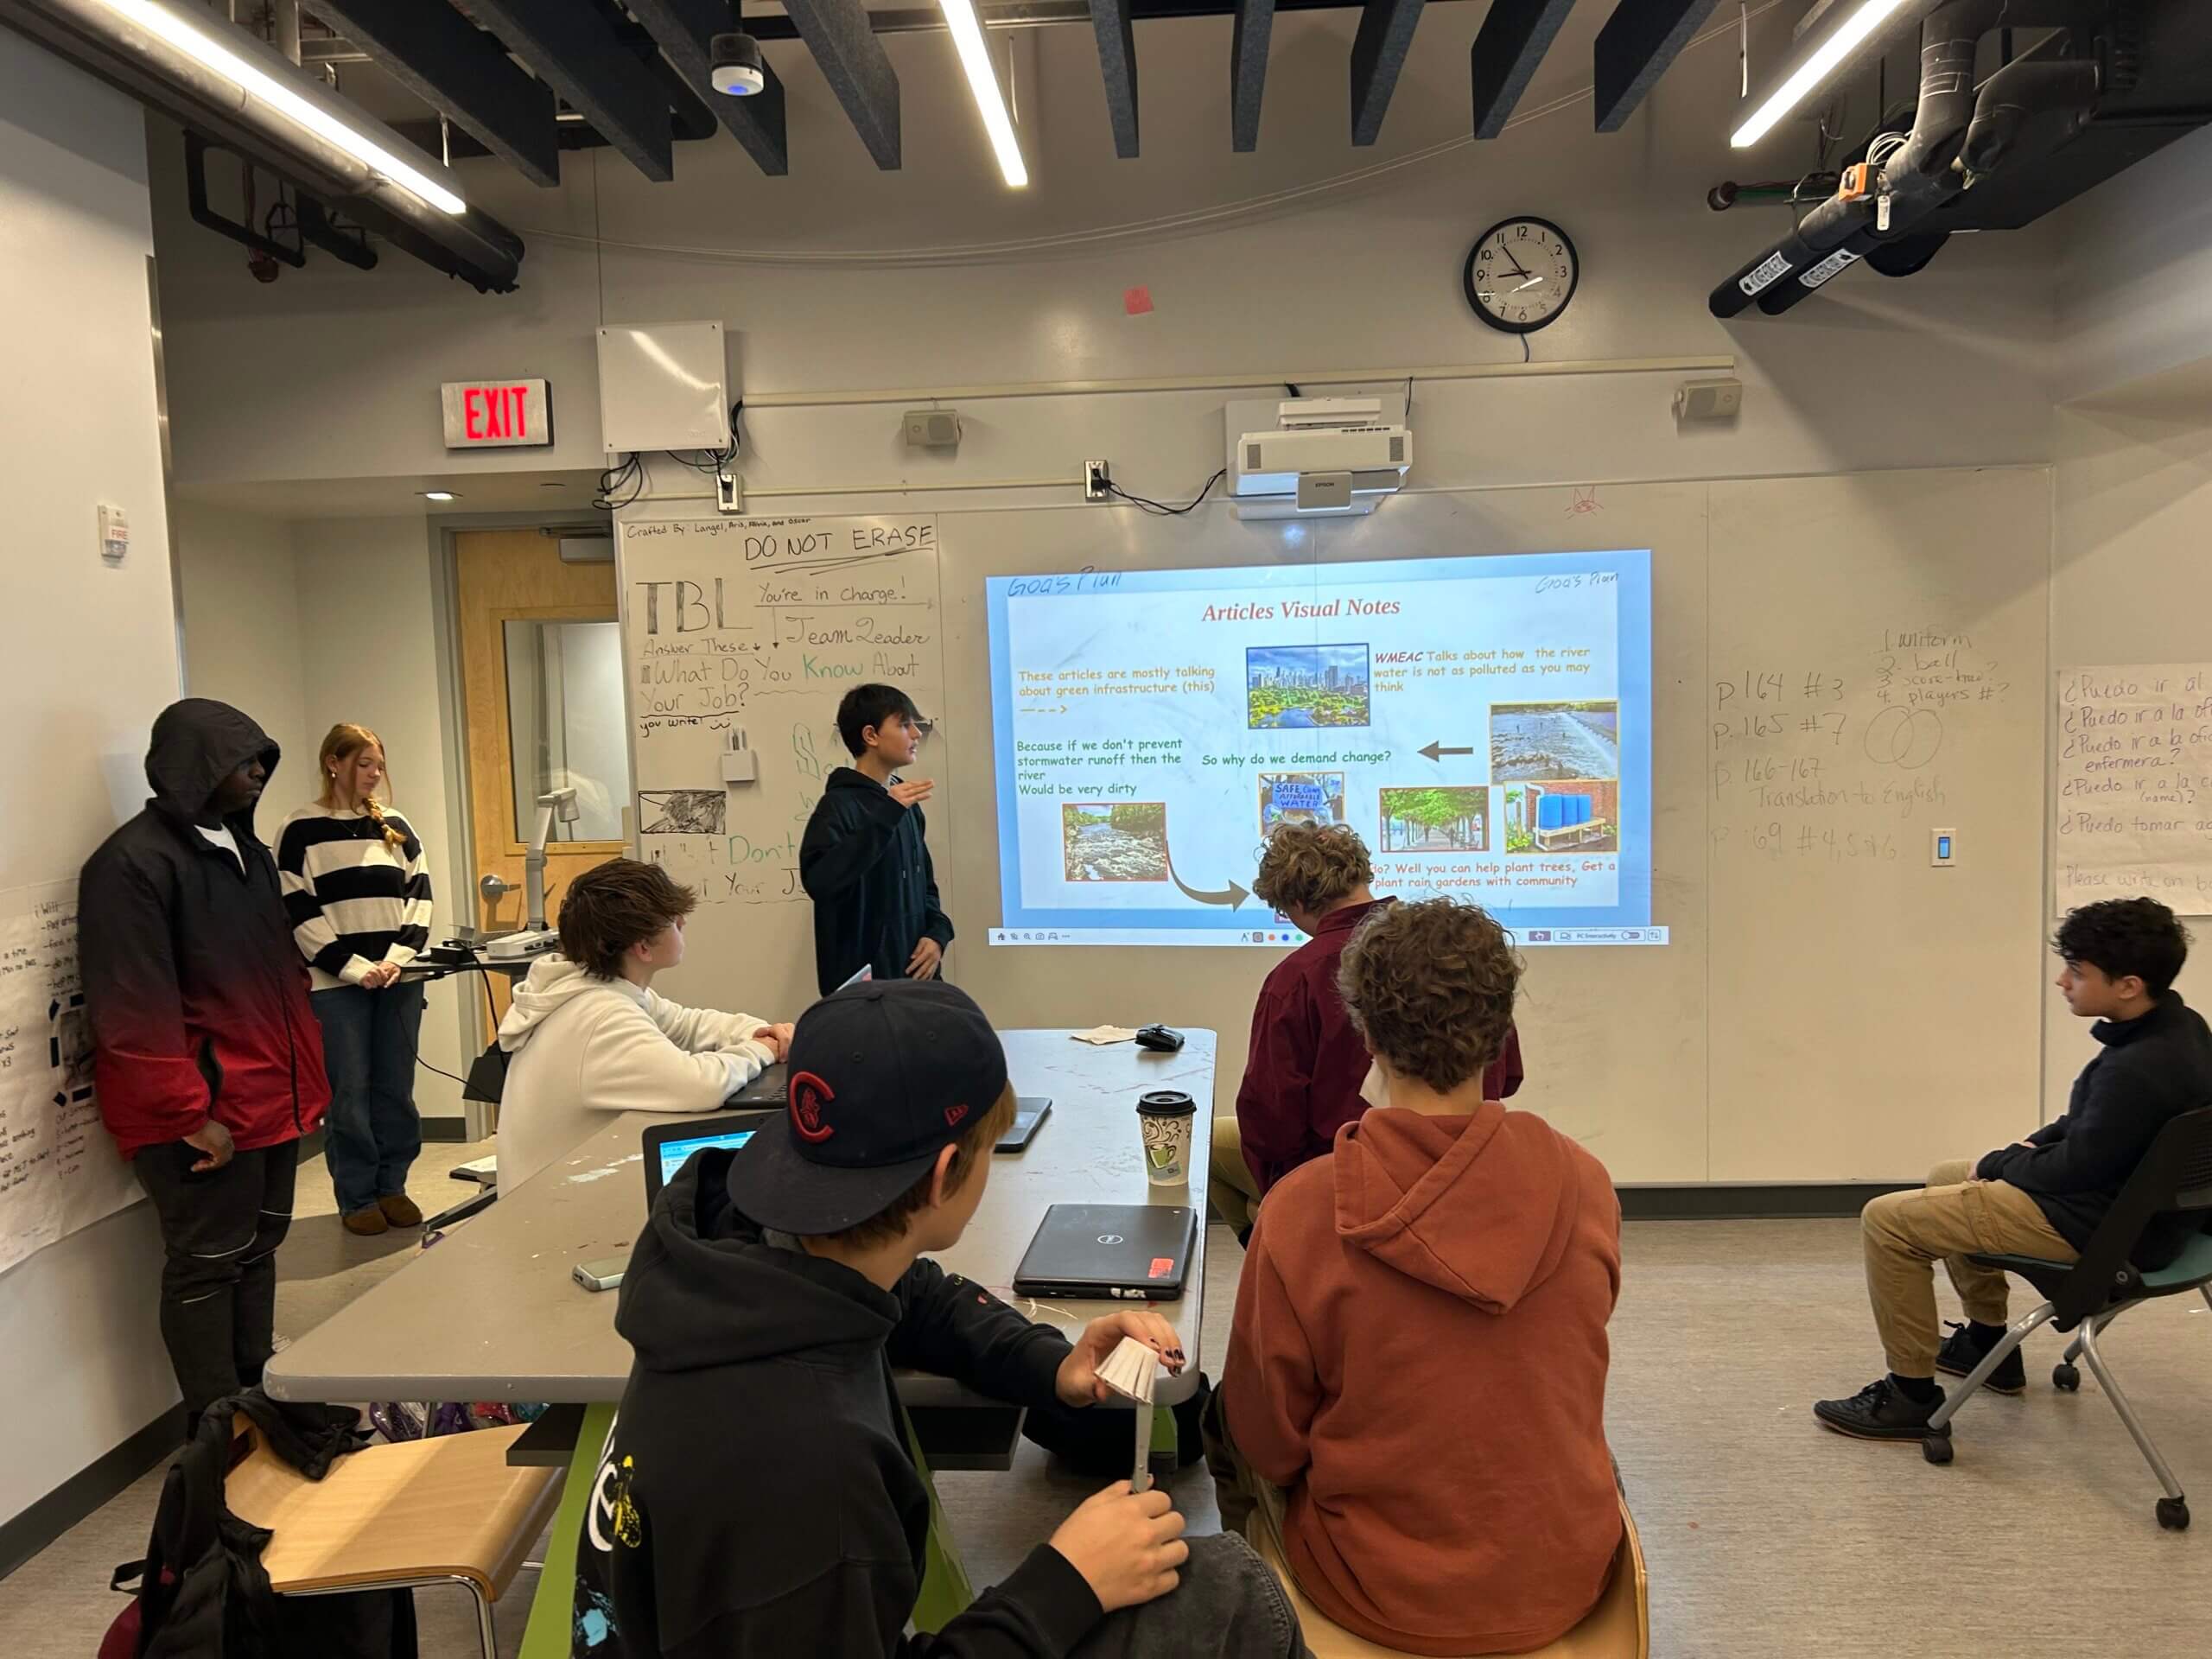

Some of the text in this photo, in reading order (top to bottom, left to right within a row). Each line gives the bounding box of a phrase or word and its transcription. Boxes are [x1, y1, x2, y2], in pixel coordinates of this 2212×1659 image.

[1497, 232, 1504, 244] 11
[1516, 226, 1528, 238] 12
[1481, 249, 1491, 261] 10
[1555, 245, 1563, 255] 2
[1477, 270, 1485, 282] 9
[1560, 266, 1567, 277] 3
[1553, 286, 1561, 297] 4
[1499, 306, 1506, 317] 7
[1518, 310, 1528, 321] 6
[1540, 303, 1547, 314] 5
[464, 387, 528, 440] EXIT
[627, 525, 667, 538] Crafted
[745, 525, 937, 561] DO NOT ERASE
[759, 582, 803, 603] You're
[816, 587, 829, 601] in
[636, 577, 753, 634] TBL
[1202, 598, 1401, 621] Articles Visual Notes
[644, 637, 748, 658] Answer These
[1375, 646, 1591, 664] WMEAC Talks about how the river
[1914, 649, 1957, 671] ball
[656, 659, 712, 684] What
[721, 658, 749, 681] Do
[754, 656, 792, 681] You
[803, 654, 864, 680] Know
[1019, 665, 1215, 682] These articles are mostly talking
[1374, 663, 1590, 678] water is not as polluted as you may
[1019, 679, 1215, 699] about green infrastructure (this)
[1374, 681, 1404, 692] think
[1745, 670, 1783, 702] 164
[2155, 678, 2170, 692] ir
[2185, 671, 2202, 692] al
[640, 681, 749, 712] Your Job?
[1909, 688, 1970, 708] players
[2134, 709, 2151, 723] ir
[2153, 708, 2163, 722] a
[2171, 702, 2184, 721] la
[640, 720, 661, 738] you
[1744, 712, 1790, 738] 165
[1017, 739, 1183, 752] Because if we don't prevent
[2132, 735, 2146, 751] ir
[2149, 736, 2162, 747] a
[1018, 753, 1182, 766] stormwater runoff then the
[1202, 750, 1392, 767] So why do we demand change?
[1018, 770, 1046, 781] river
[1745, 758, 1824, 783] 166-167
[2134, 779, 2145, 790] ir
[2158, 779, 2167, 789] a
[2177, 772, 2190, 789] la
[1020, 783, 1137, 797] Would be very dirty
[1749, 777, 1946, 819] Translation to English
[2131, 817, 2185, 831] tomar
[729, 831, 796, 865] Don't
[1395, 863, 1421, 874] Well
[1427, 866, 1447, 875] you
[1452, 865, 1471, 874] can
[1476, 862, 1500, 874] help
[1505, 862, 1534, 874] plant
[1540, 861, 1575, 873] trees,
[1581, 861, 1605, 872] Get
[2066, 864, 2109, 888] Please
[2164, 875, 2184, 887] on
[1375, 875, 1578, 889] plant rain gardens with community
[789, 1071, 836, 1143] C
